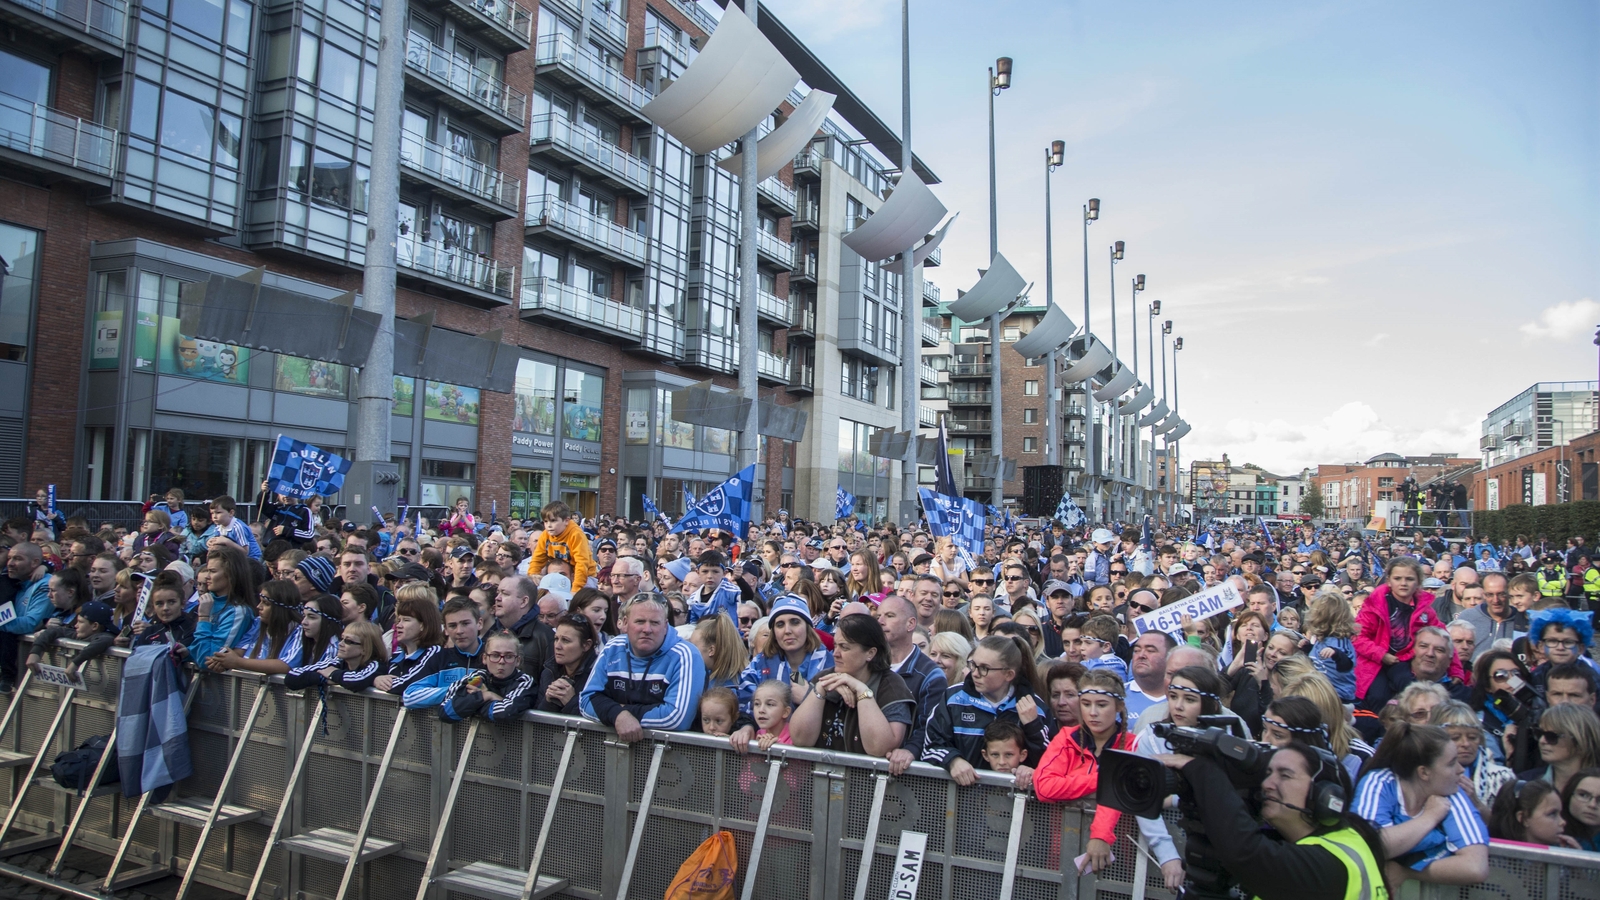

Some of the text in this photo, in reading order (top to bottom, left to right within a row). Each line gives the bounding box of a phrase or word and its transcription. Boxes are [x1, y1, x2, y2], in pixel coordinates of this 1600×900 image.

[512, 436, 553, 448] Paddy Power
[564, 442, 582, 453] Paddy
[291, 450, 336, 474] DUBLIN
[280, 484, 299, 495] BOYS
[1524, 477, 1532, 503] SPAR
[1149, 594, 1224, 631] 16-DSAM
[1158, 605, 1174, 615] BAILE
[1188, 594, 1207, 604] CLIATH
